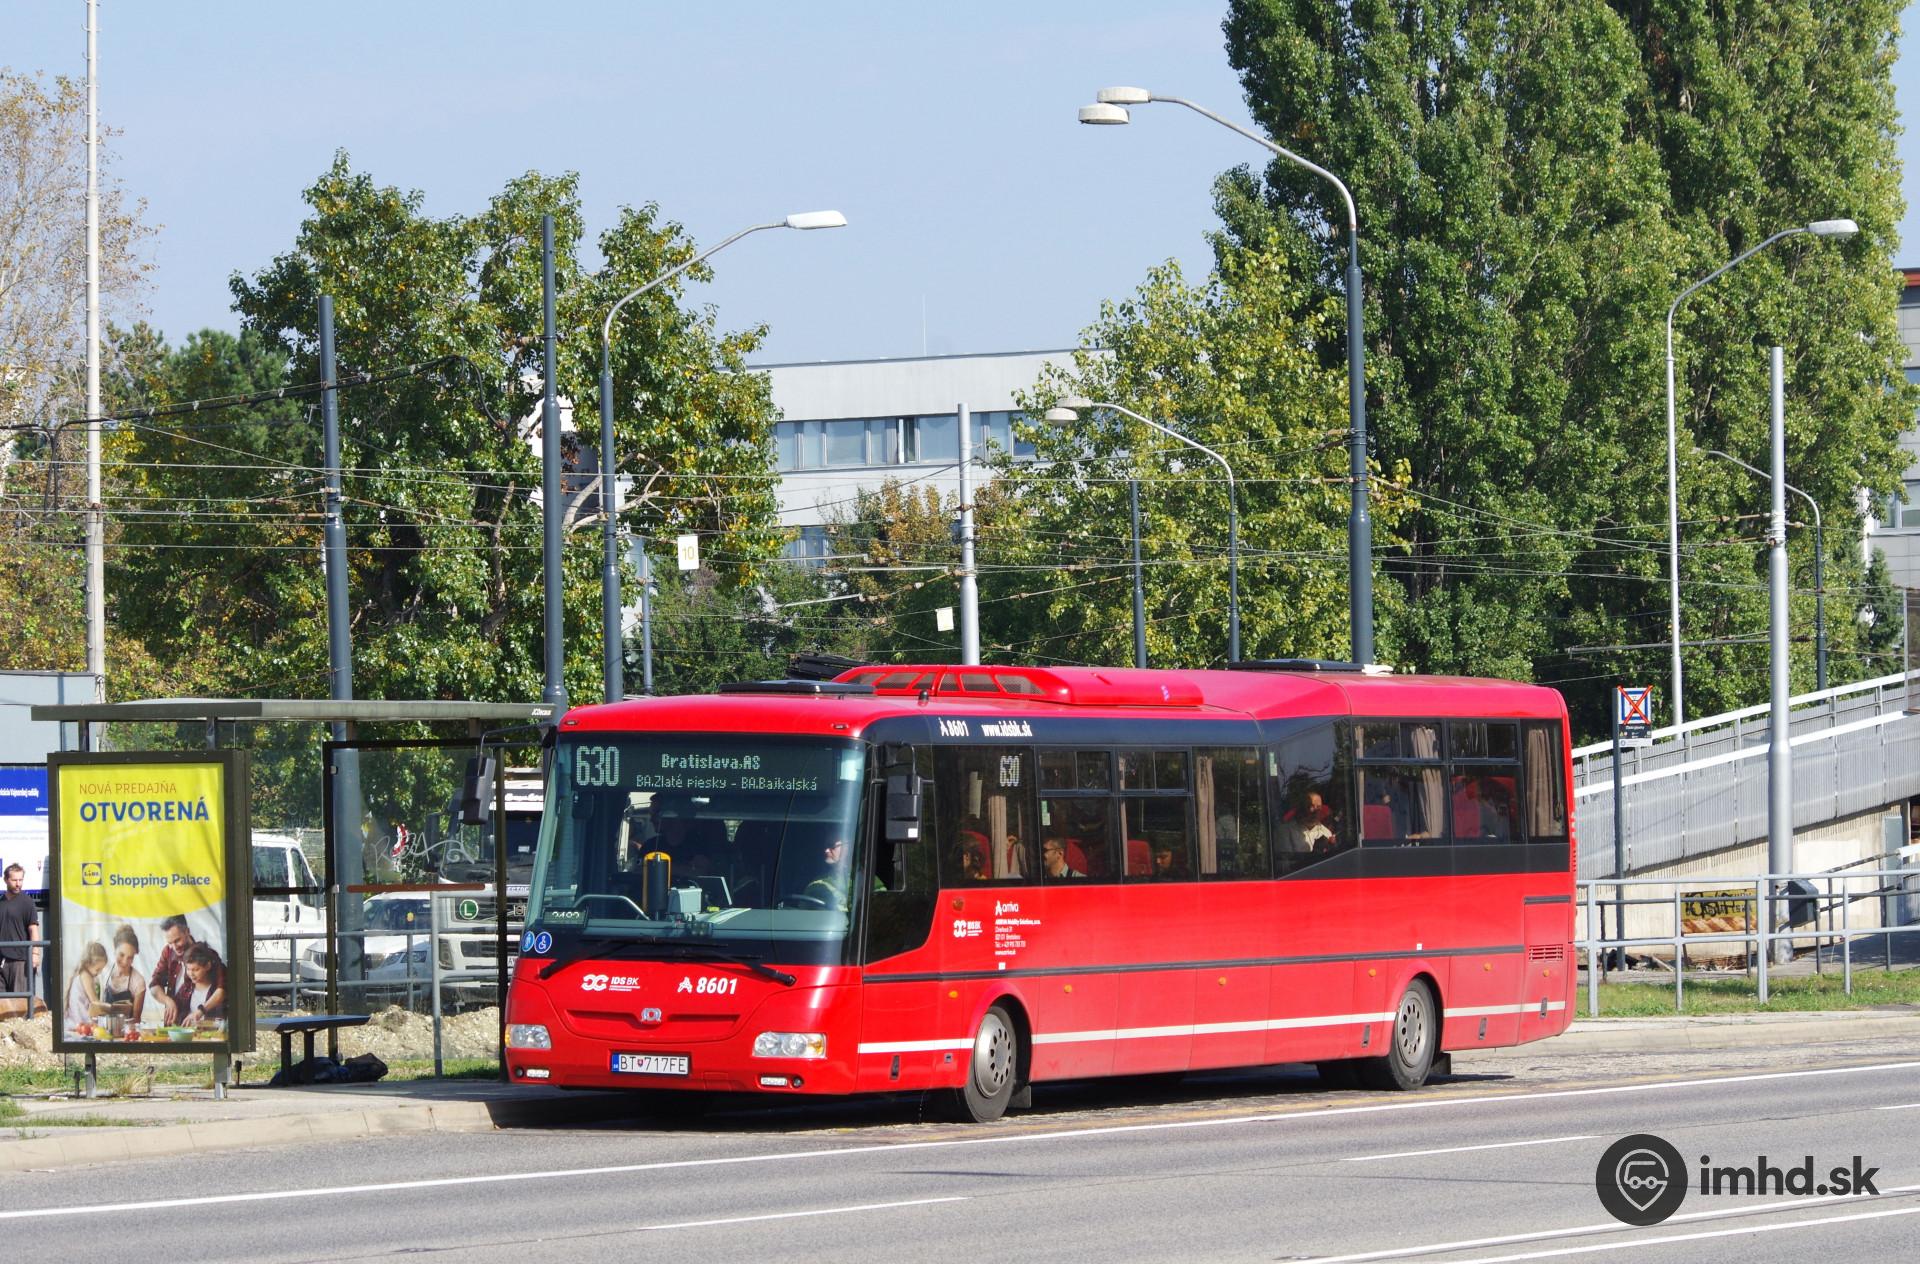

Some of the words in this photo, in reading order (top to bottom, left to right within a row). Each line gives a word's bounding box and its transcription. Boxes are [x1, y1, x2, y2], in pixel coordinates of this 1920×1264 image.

[682, 546, 695, 560] 10
[947, 720, 969, 737] 8601
[576, 745, 620, 787] 630
[1000, 755, 1019, 787] 630
[79, 781, 112, 795] NOVÁ
[115, 781, 177, 795] PREDAJŇA
[636, 774, 683, 788] BA.Zlaté
[741, 776, 817, 791] BA.Bajkalská
[80, 796, 209, 822] OTVORENÁ
[109, 873, 168, 888] Shopping
[172, 874, 211, 885] Palace
[696, 976, 738, 994] 8601
[620, 1055, 636, 1070] BT
[644, 1057, 687, 1072] 717FE
